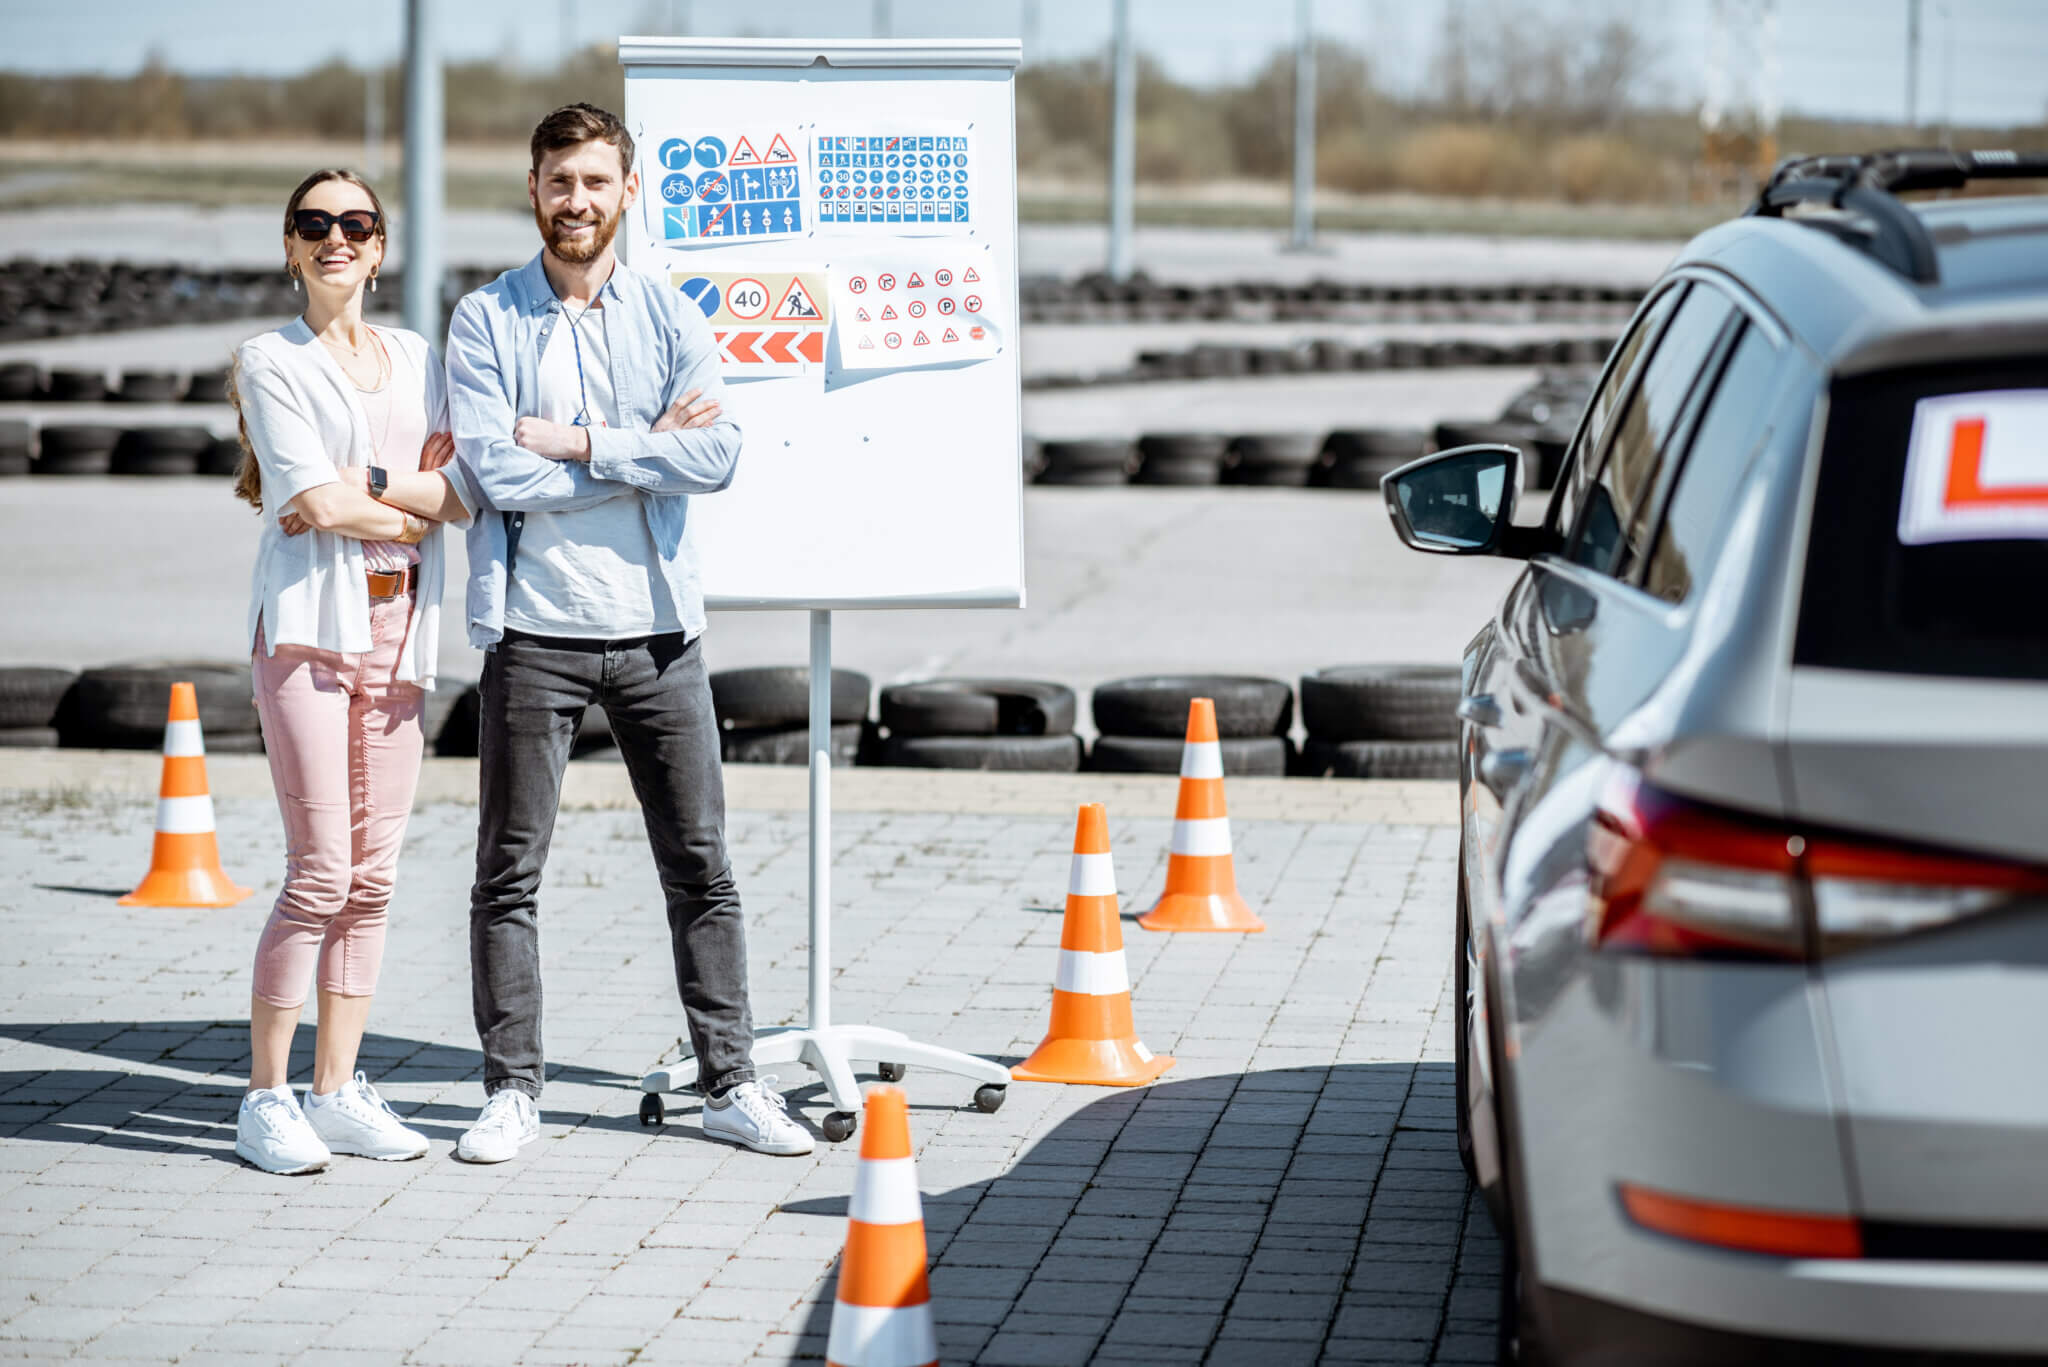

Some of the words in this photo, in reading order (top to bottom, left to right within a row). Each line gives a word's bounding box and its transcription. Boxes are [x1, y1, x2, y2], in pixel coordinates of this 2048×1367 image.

[838, 172, 849, 181] 30
[939, 273, 950, 282] 40
[734, 290, 761, 307] 40
[943, 301, 952, 312] P
[1944, 419, 2048, 509] L
